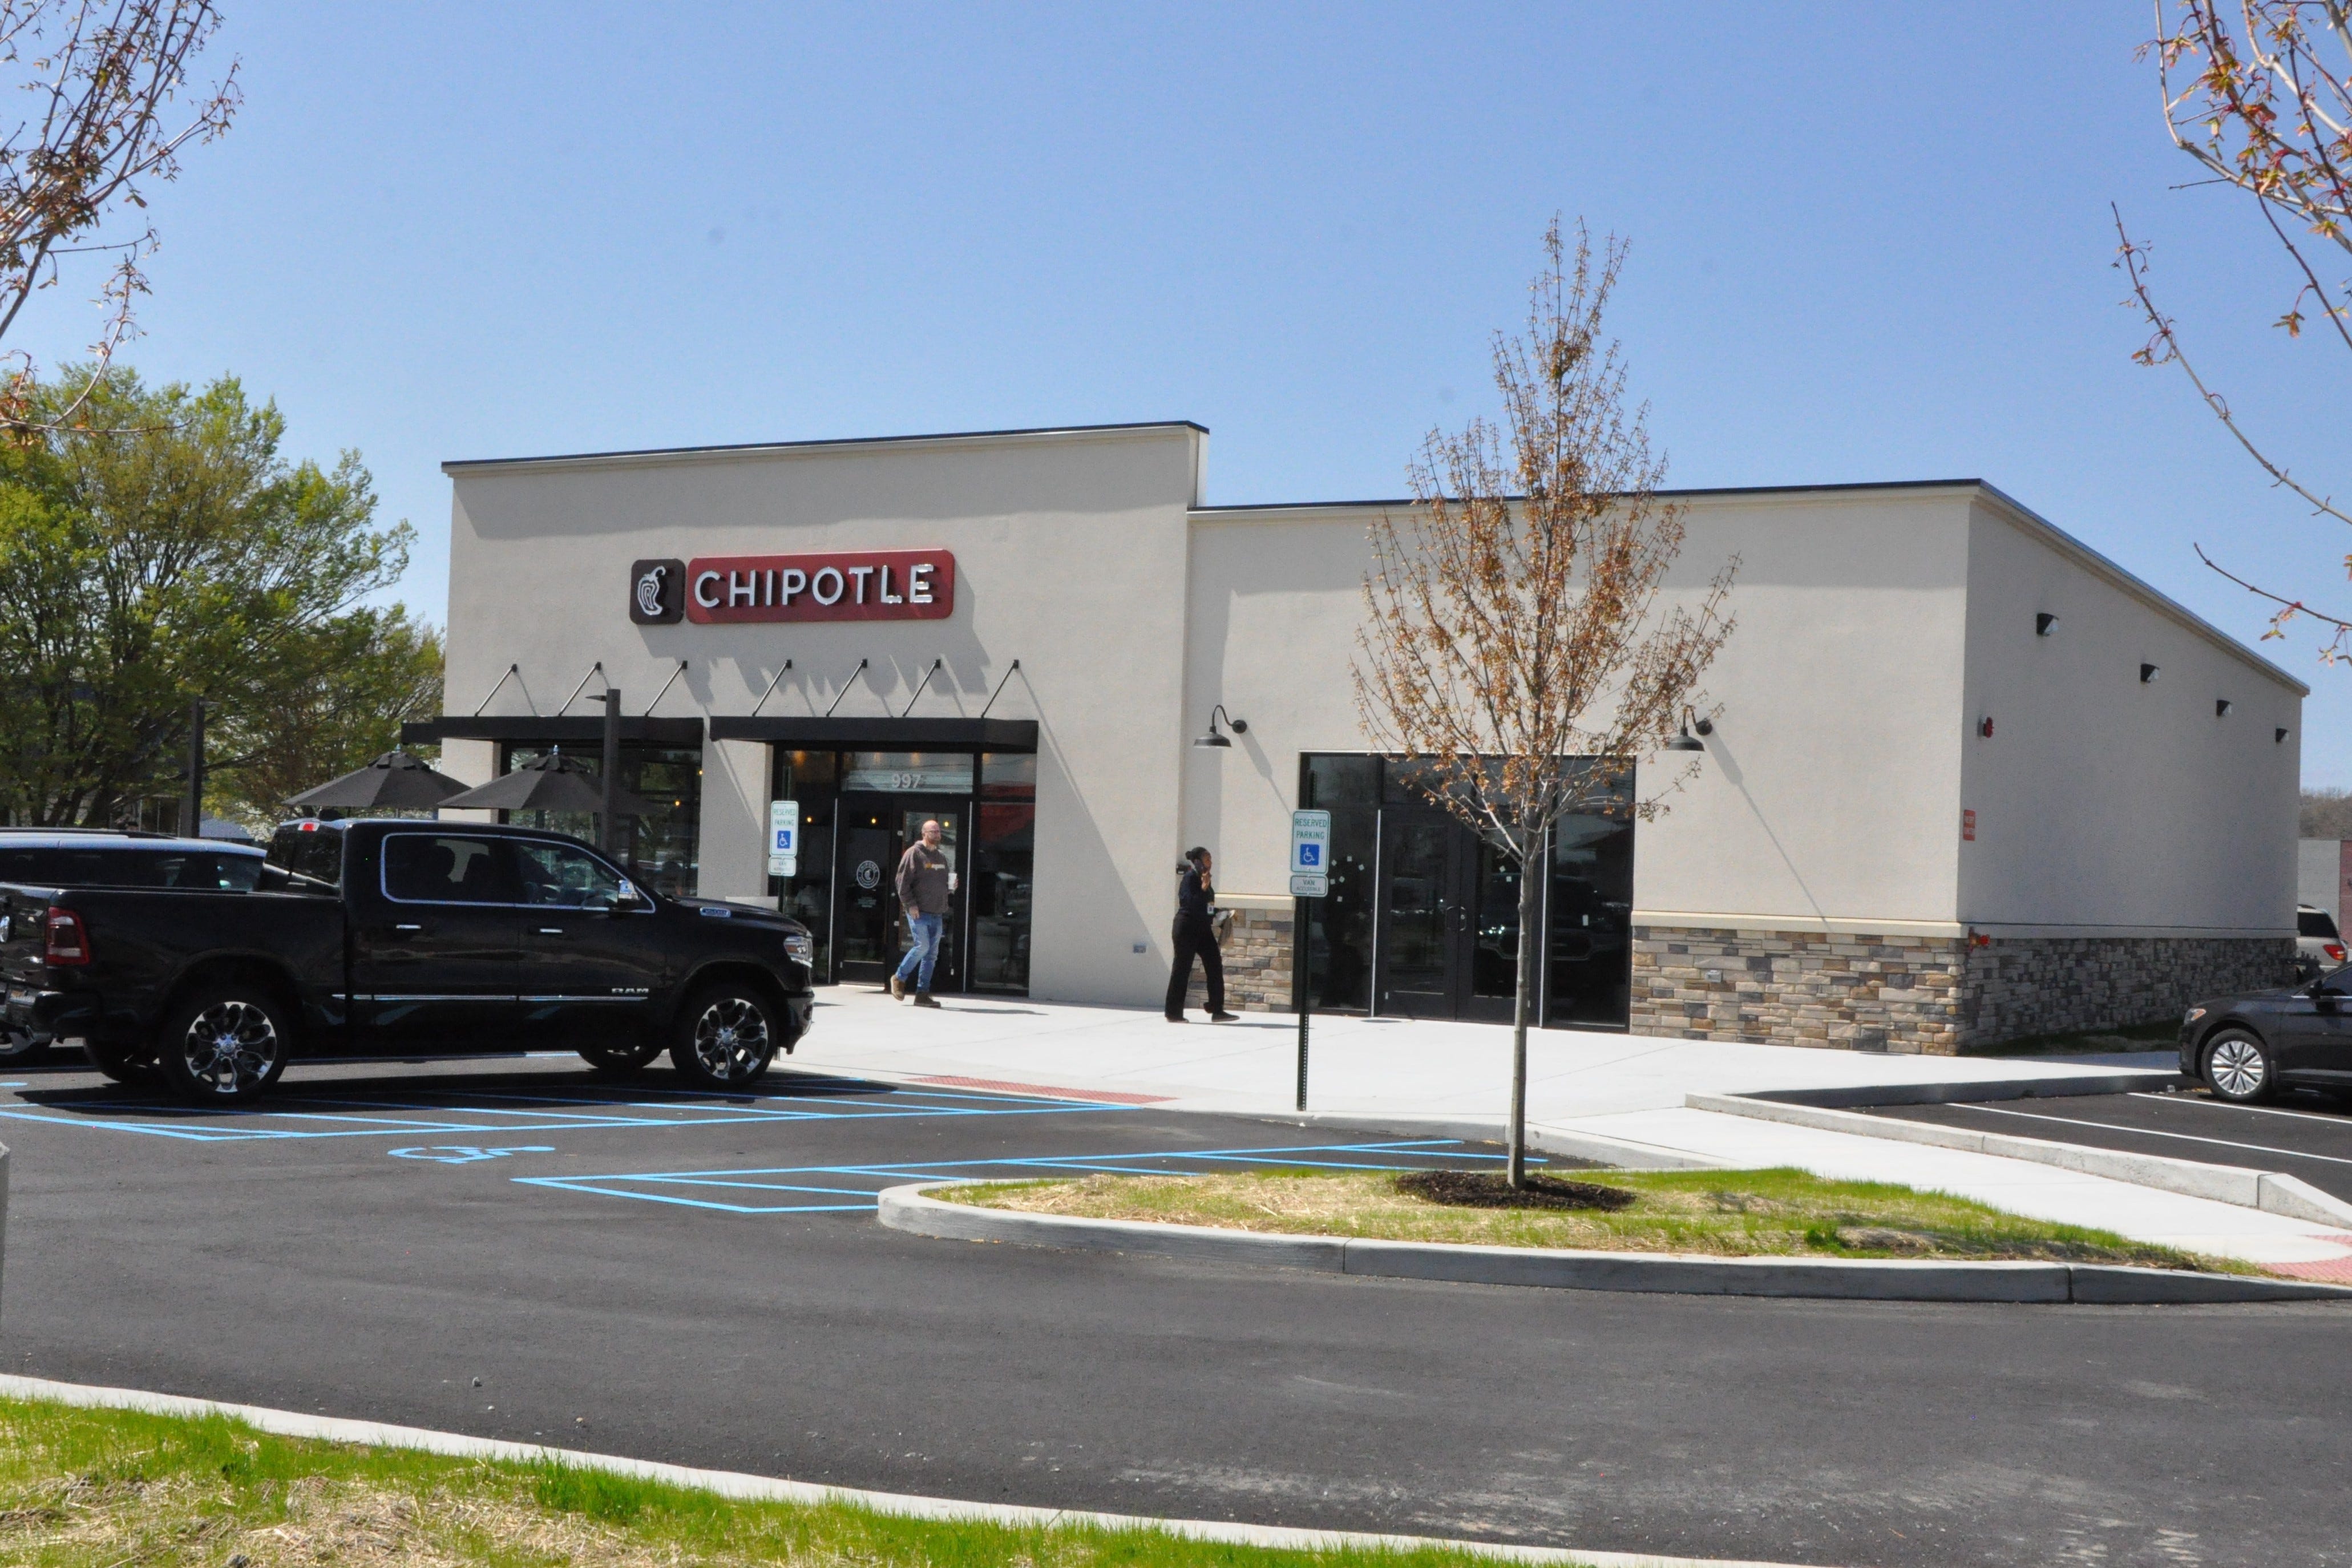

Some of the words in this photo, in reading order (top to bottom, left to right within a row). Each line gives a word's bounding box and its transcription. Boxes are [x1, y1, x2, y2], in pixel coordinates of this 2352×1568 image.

[694, 564, 934, 608] CHIPOTLE
[891, 773, 922, 788] 997
[1295, 818, 1327, 827] RESERVED
[1296, 830, 1324, 839] PARKING
